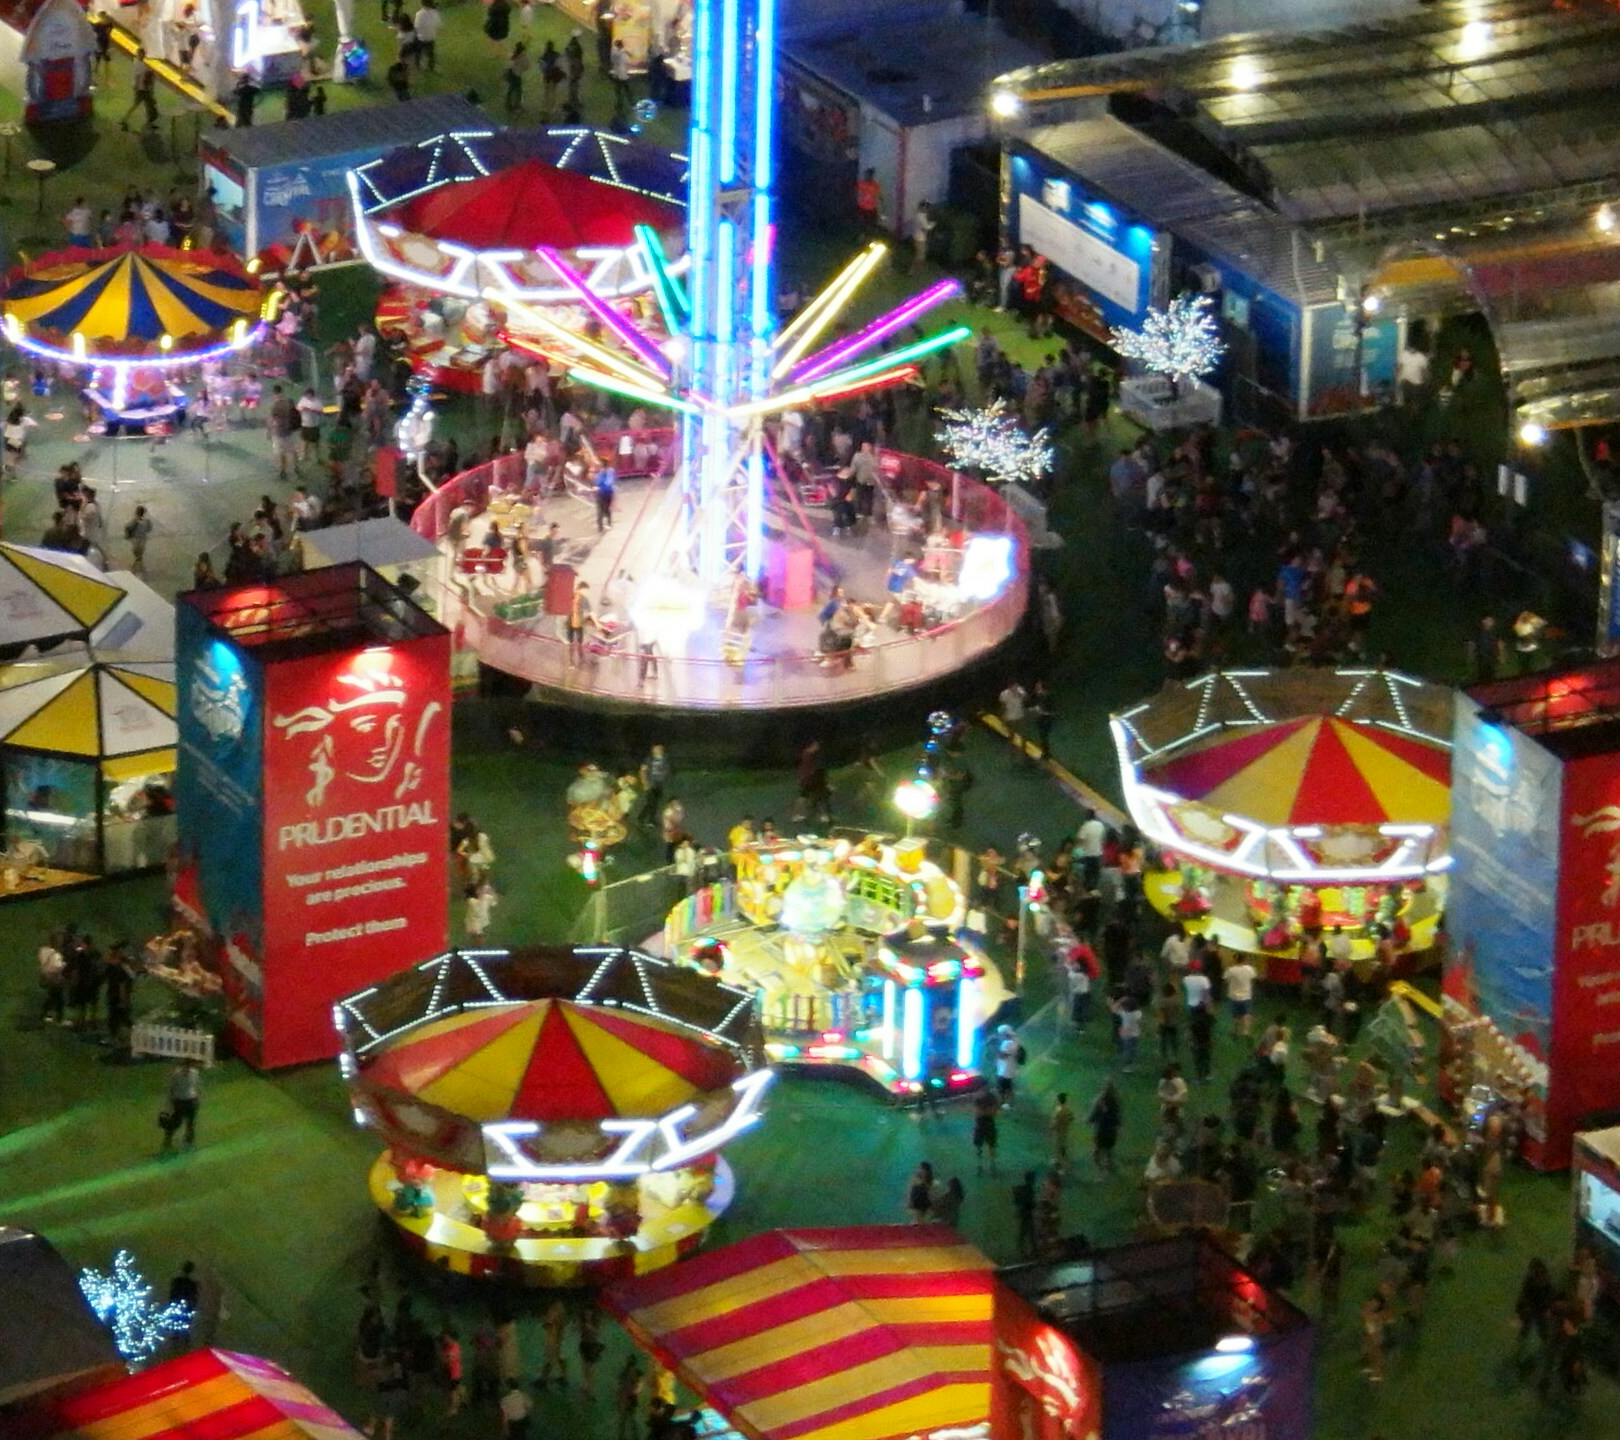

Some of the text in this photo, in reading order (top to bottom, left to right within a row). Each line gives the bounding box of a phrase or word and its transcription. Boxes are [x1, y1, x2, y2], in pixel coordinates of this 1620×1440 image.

[278, 799, 439, 851] PRUDENTIAL
[286, 852, 429, 888] Your relationships
[305, 891, 332, 906] are
[305, 922, 363, 947] Protect
